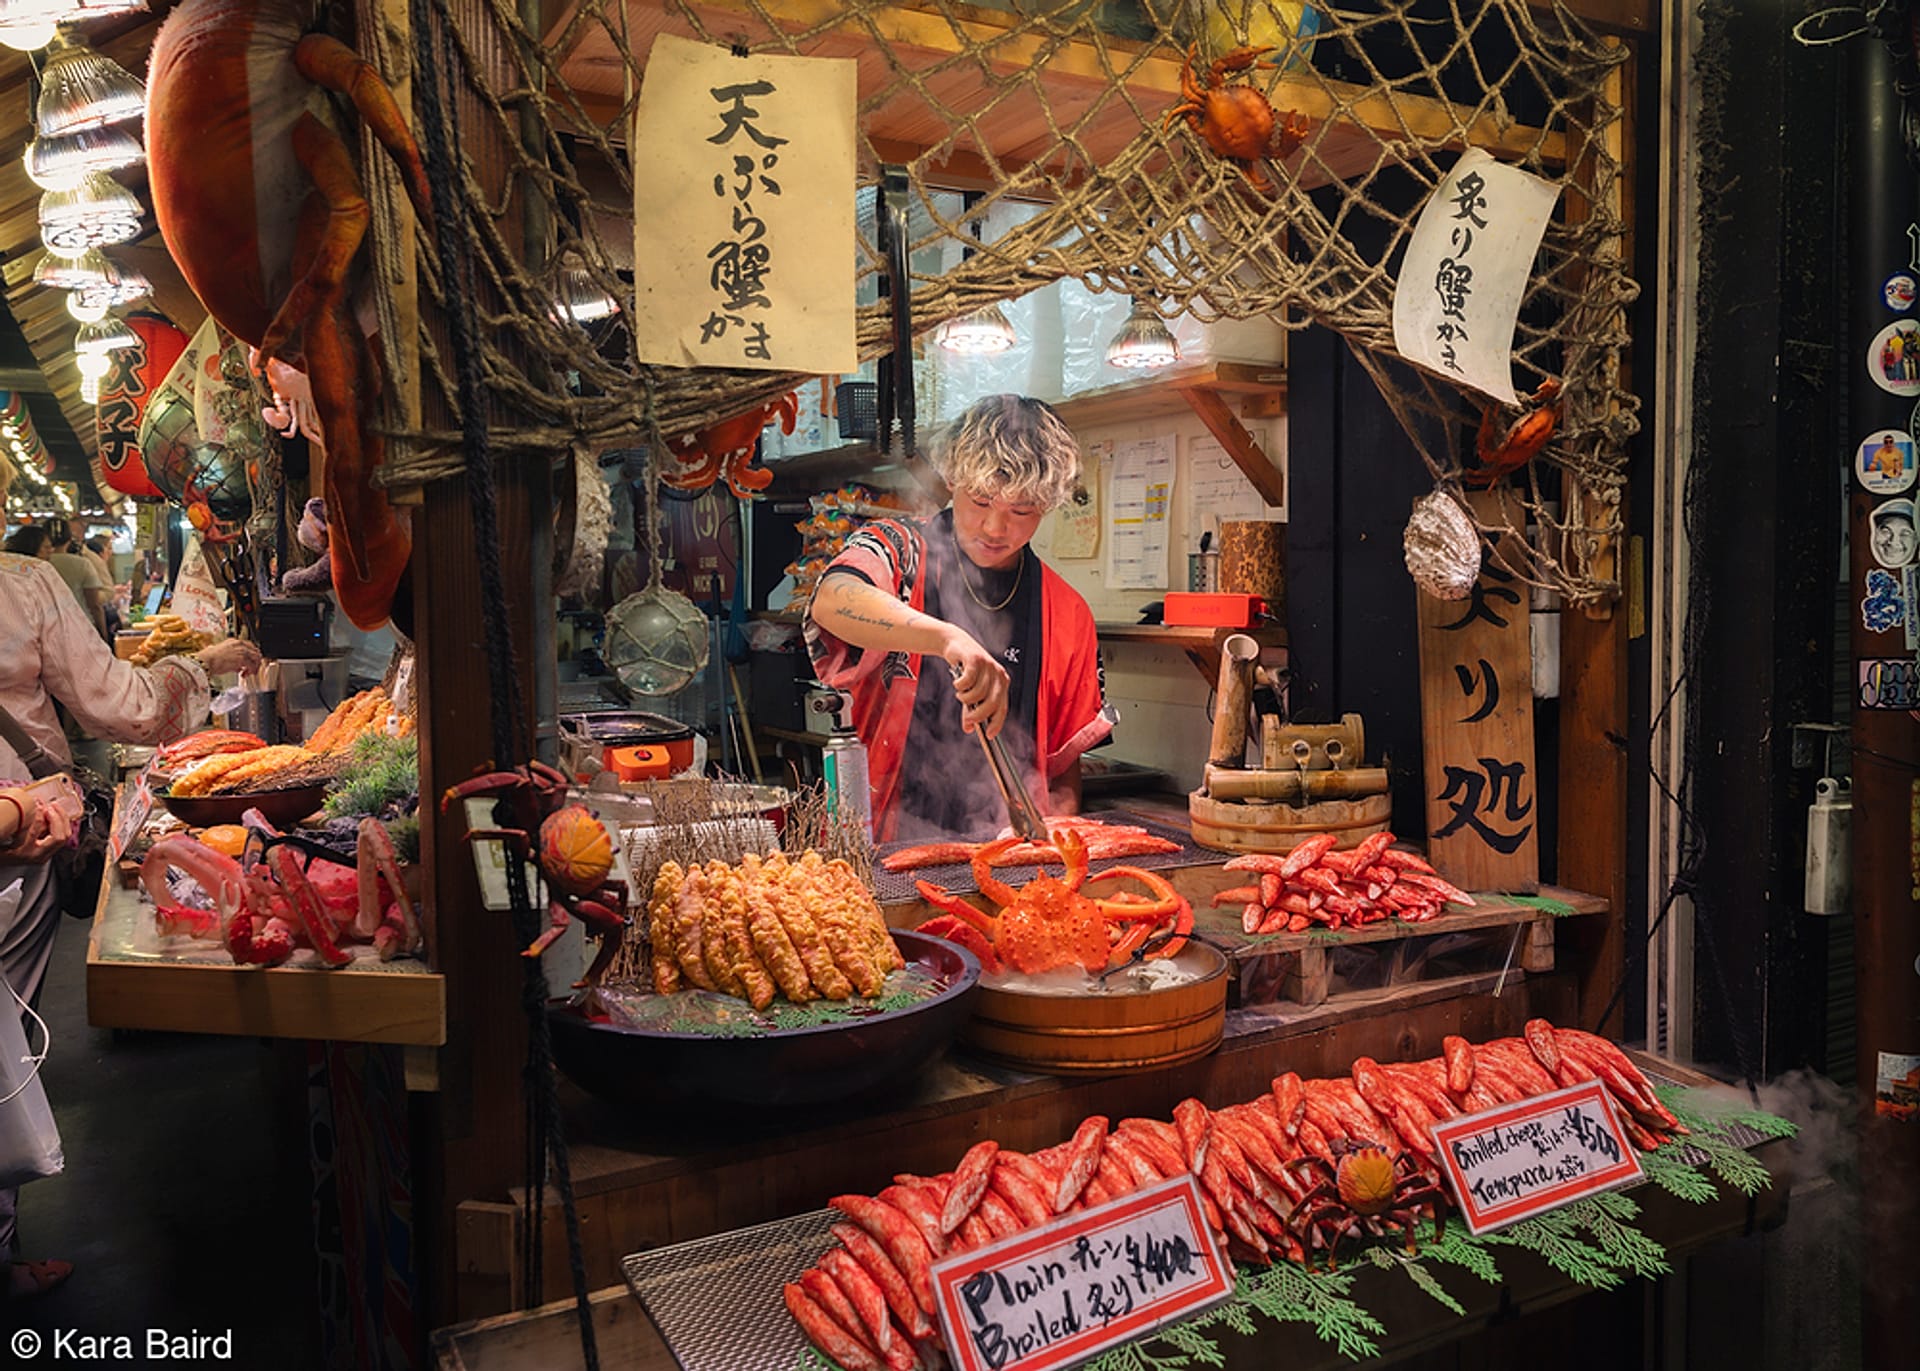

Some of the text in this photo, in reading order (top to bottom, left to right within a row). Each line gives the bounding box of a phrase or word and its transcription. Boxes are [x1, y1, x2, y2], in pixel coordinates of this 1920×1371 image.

[700, 79, 790, 361] 天ぷら蟹かま
[1435, 170, 1489, 374] 炙り蟹かま
[1452, 1126, 1507, 1171] Grilled
[1470, 1165, 1554, 1206] Tempura
[960, 1263, 1066, 1325] Plain
